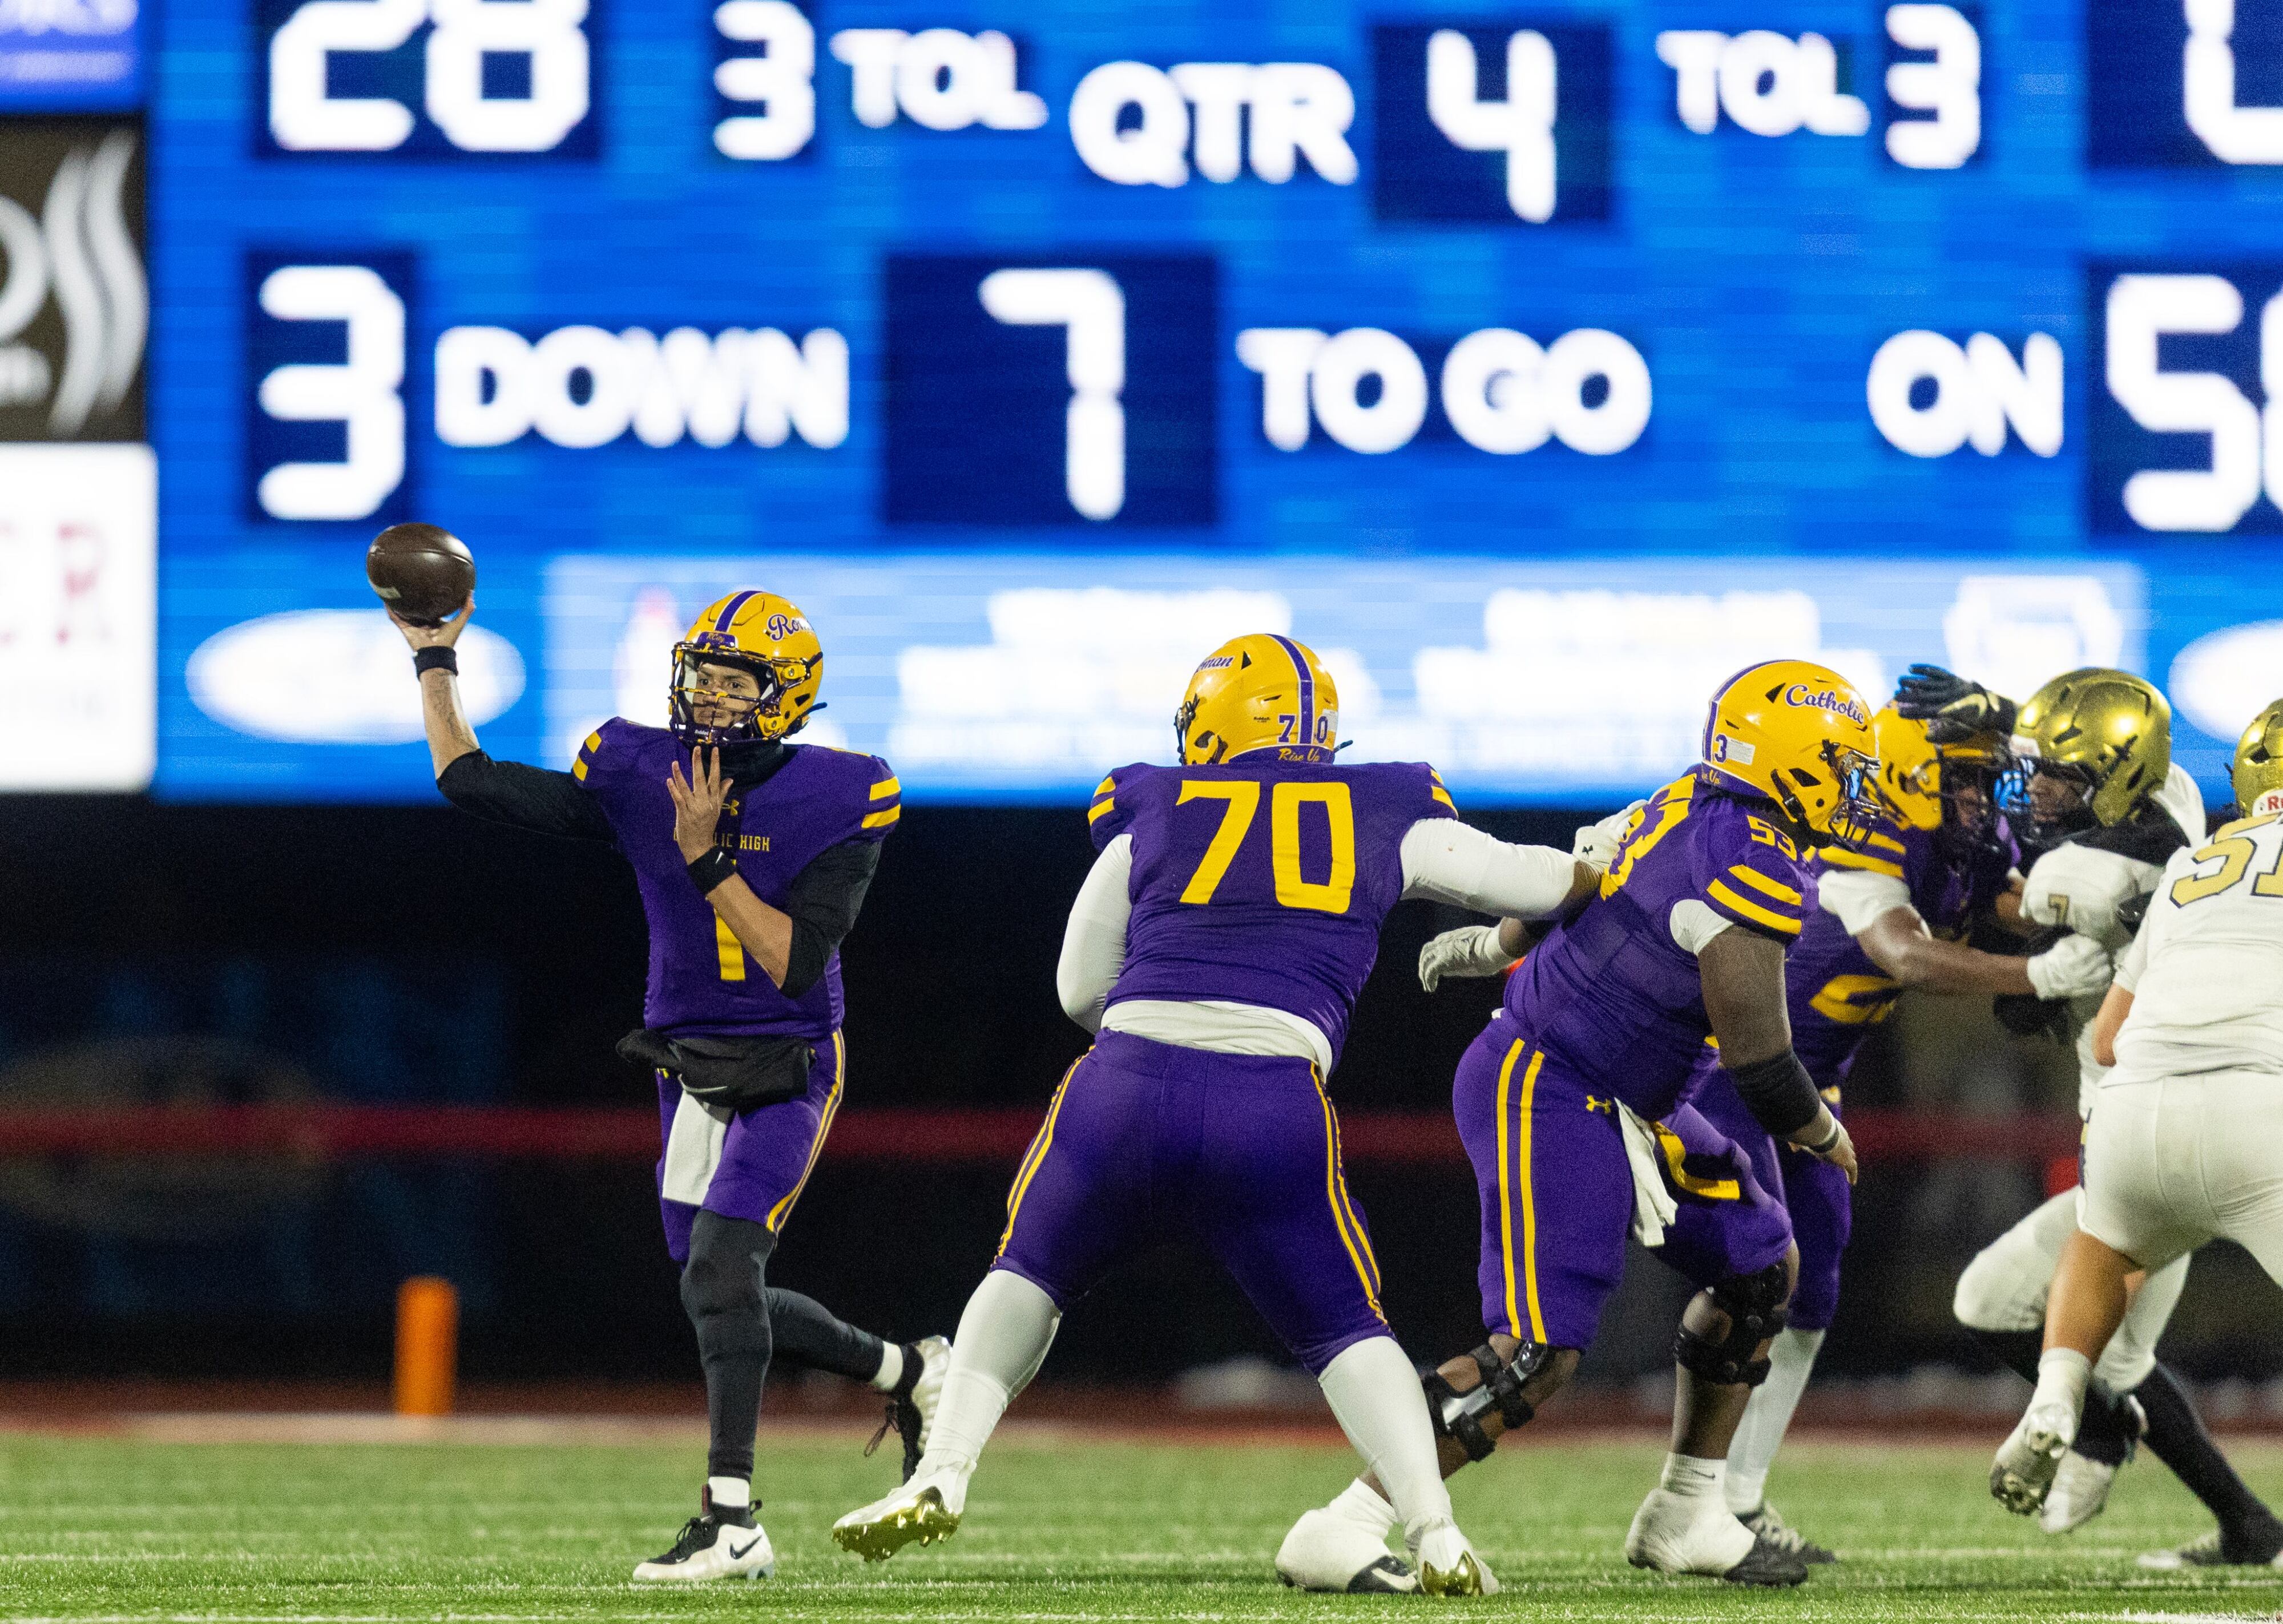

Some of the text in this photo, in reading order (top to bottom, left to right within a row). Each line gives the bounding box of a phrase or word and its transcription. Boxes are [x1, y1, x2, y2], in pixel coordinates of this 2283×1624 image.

[271, 0, 589, 152] 28
[715, 0, 1048, 160] 3 TOL
[1069, 30, 1556, 223] QTR 4
[1656, 4, 1981, 169] TOL 3
[260, 266, 405, 520] 3
[435, 326, 849, 447] DOWN
[979, 268, 1652, 518] 7 TO GO
[1867, 274, 2283, 531] ON 5
[1277, 714, 1328, 744] 7 0
[1278, 747, 1305, 761] Rise
[1715, 733, 1728, 763] 3
[1786, 684, 1864, 724] Catholic
[740, 834, 770, 852] HIGH
[1176, 779, 1356, 914] 70
[1746, 814, 1798, 862] 53
[2047, 893, 2070, 924] 7
